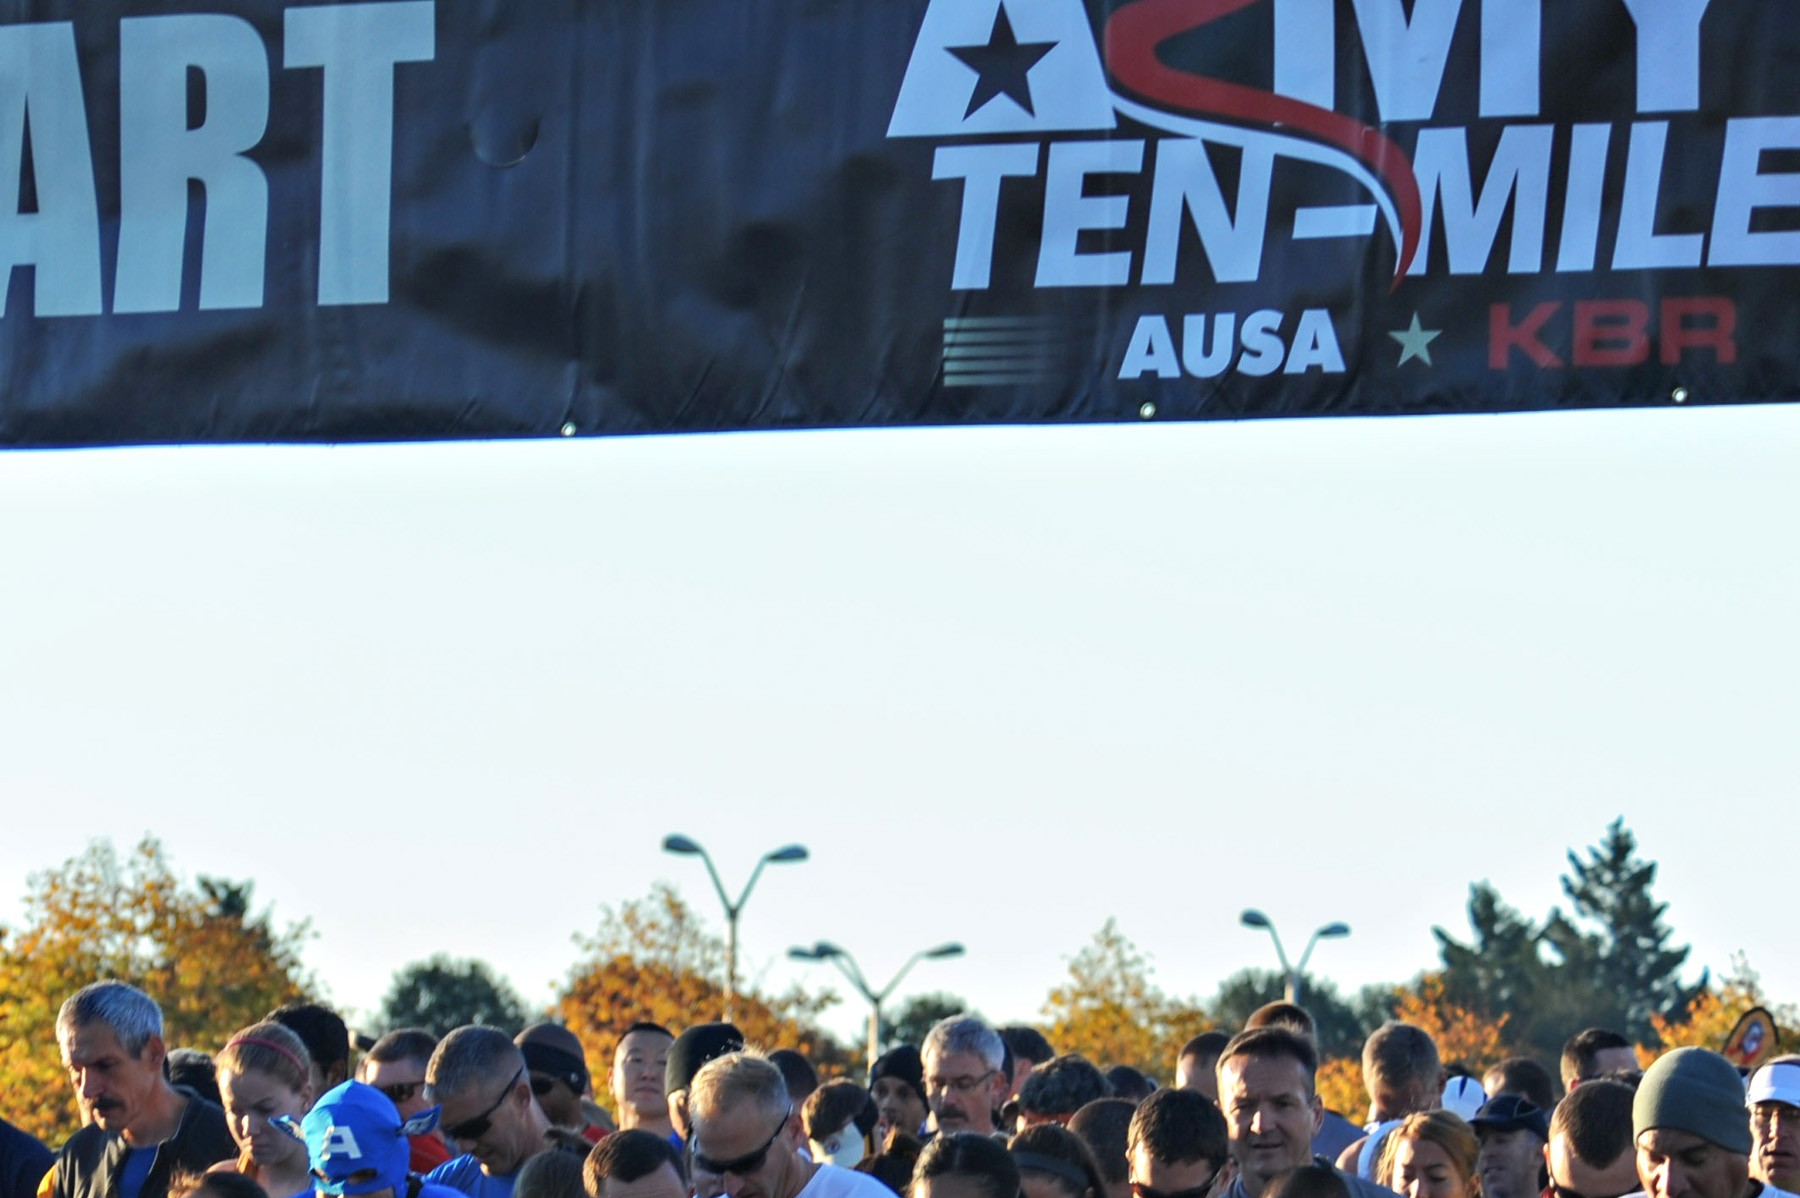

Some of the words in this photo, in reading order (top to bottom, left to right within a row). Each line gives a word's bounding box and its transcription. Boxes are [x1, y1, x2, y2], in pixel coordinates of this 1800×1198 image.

[1117, 308, 1346, 381] AUSA
[1488, 297, 1738, 371] KBR
[320, 1125, 362, 1160] A
